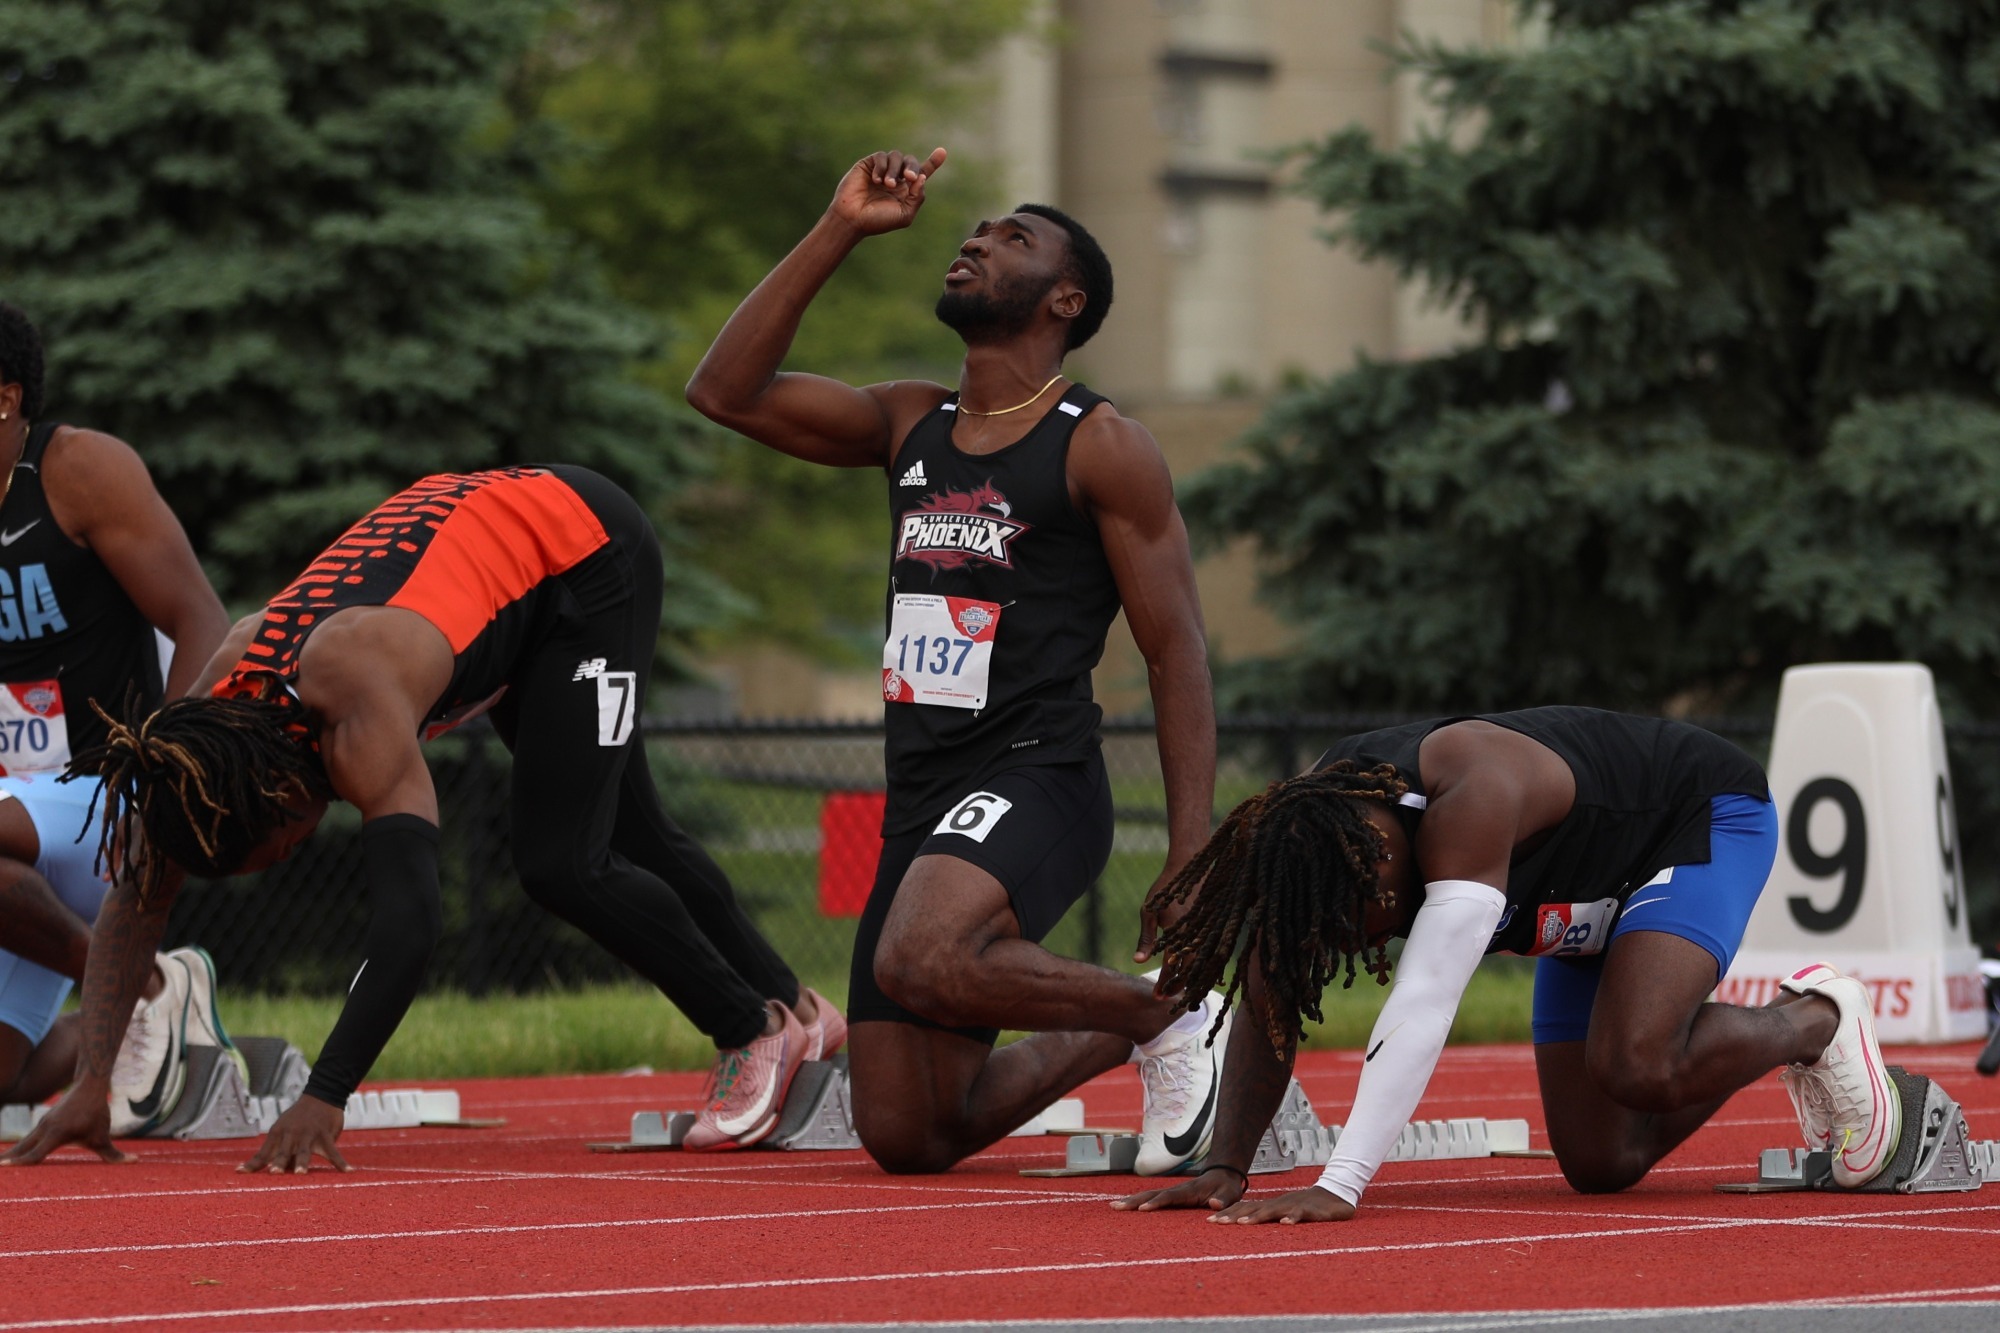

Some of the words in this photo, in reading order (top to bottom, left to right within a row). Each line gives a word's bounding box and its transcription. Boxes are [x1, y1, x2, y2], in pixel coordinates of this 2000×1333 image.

[899, 476, 927, 487] adidas
[898, 516, 1016, 559] PHOENIX
[922, 515, 989, 527] CUMBERLAND
[898, 634, 974, 676] 1137
[607, 677, 630, 742] 7
[949, 795, 999, 831] 6
[1786, 776, 1867, 935] 9
[1936, 773, 1959, 932] 9
